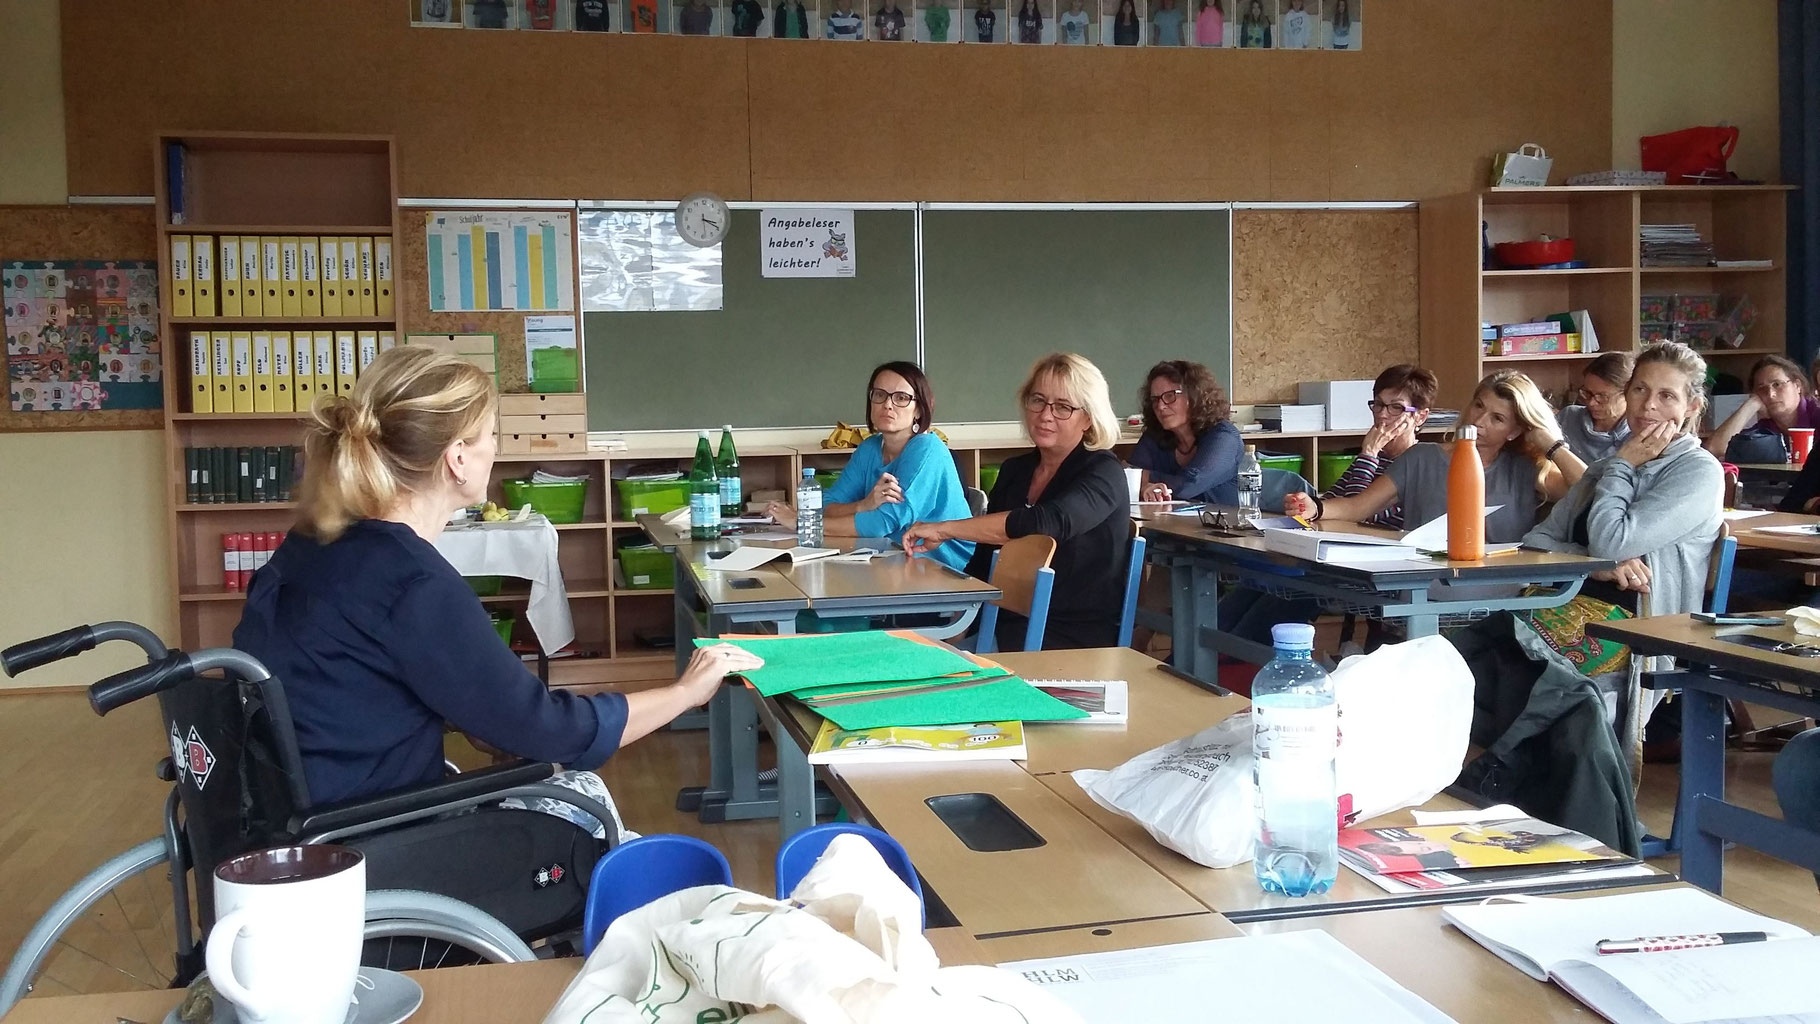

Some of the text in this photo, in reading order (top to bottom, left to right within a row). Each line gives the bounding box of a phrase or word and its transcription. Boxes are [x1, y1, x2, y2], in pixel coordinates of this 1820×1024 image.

[1505, 178, 1541, 187] PALMERS
[768, 217, 840, 230] Angabeleser
[768, 237, 815, 248] haben's
[768, 257, 822, 268] leichter!
